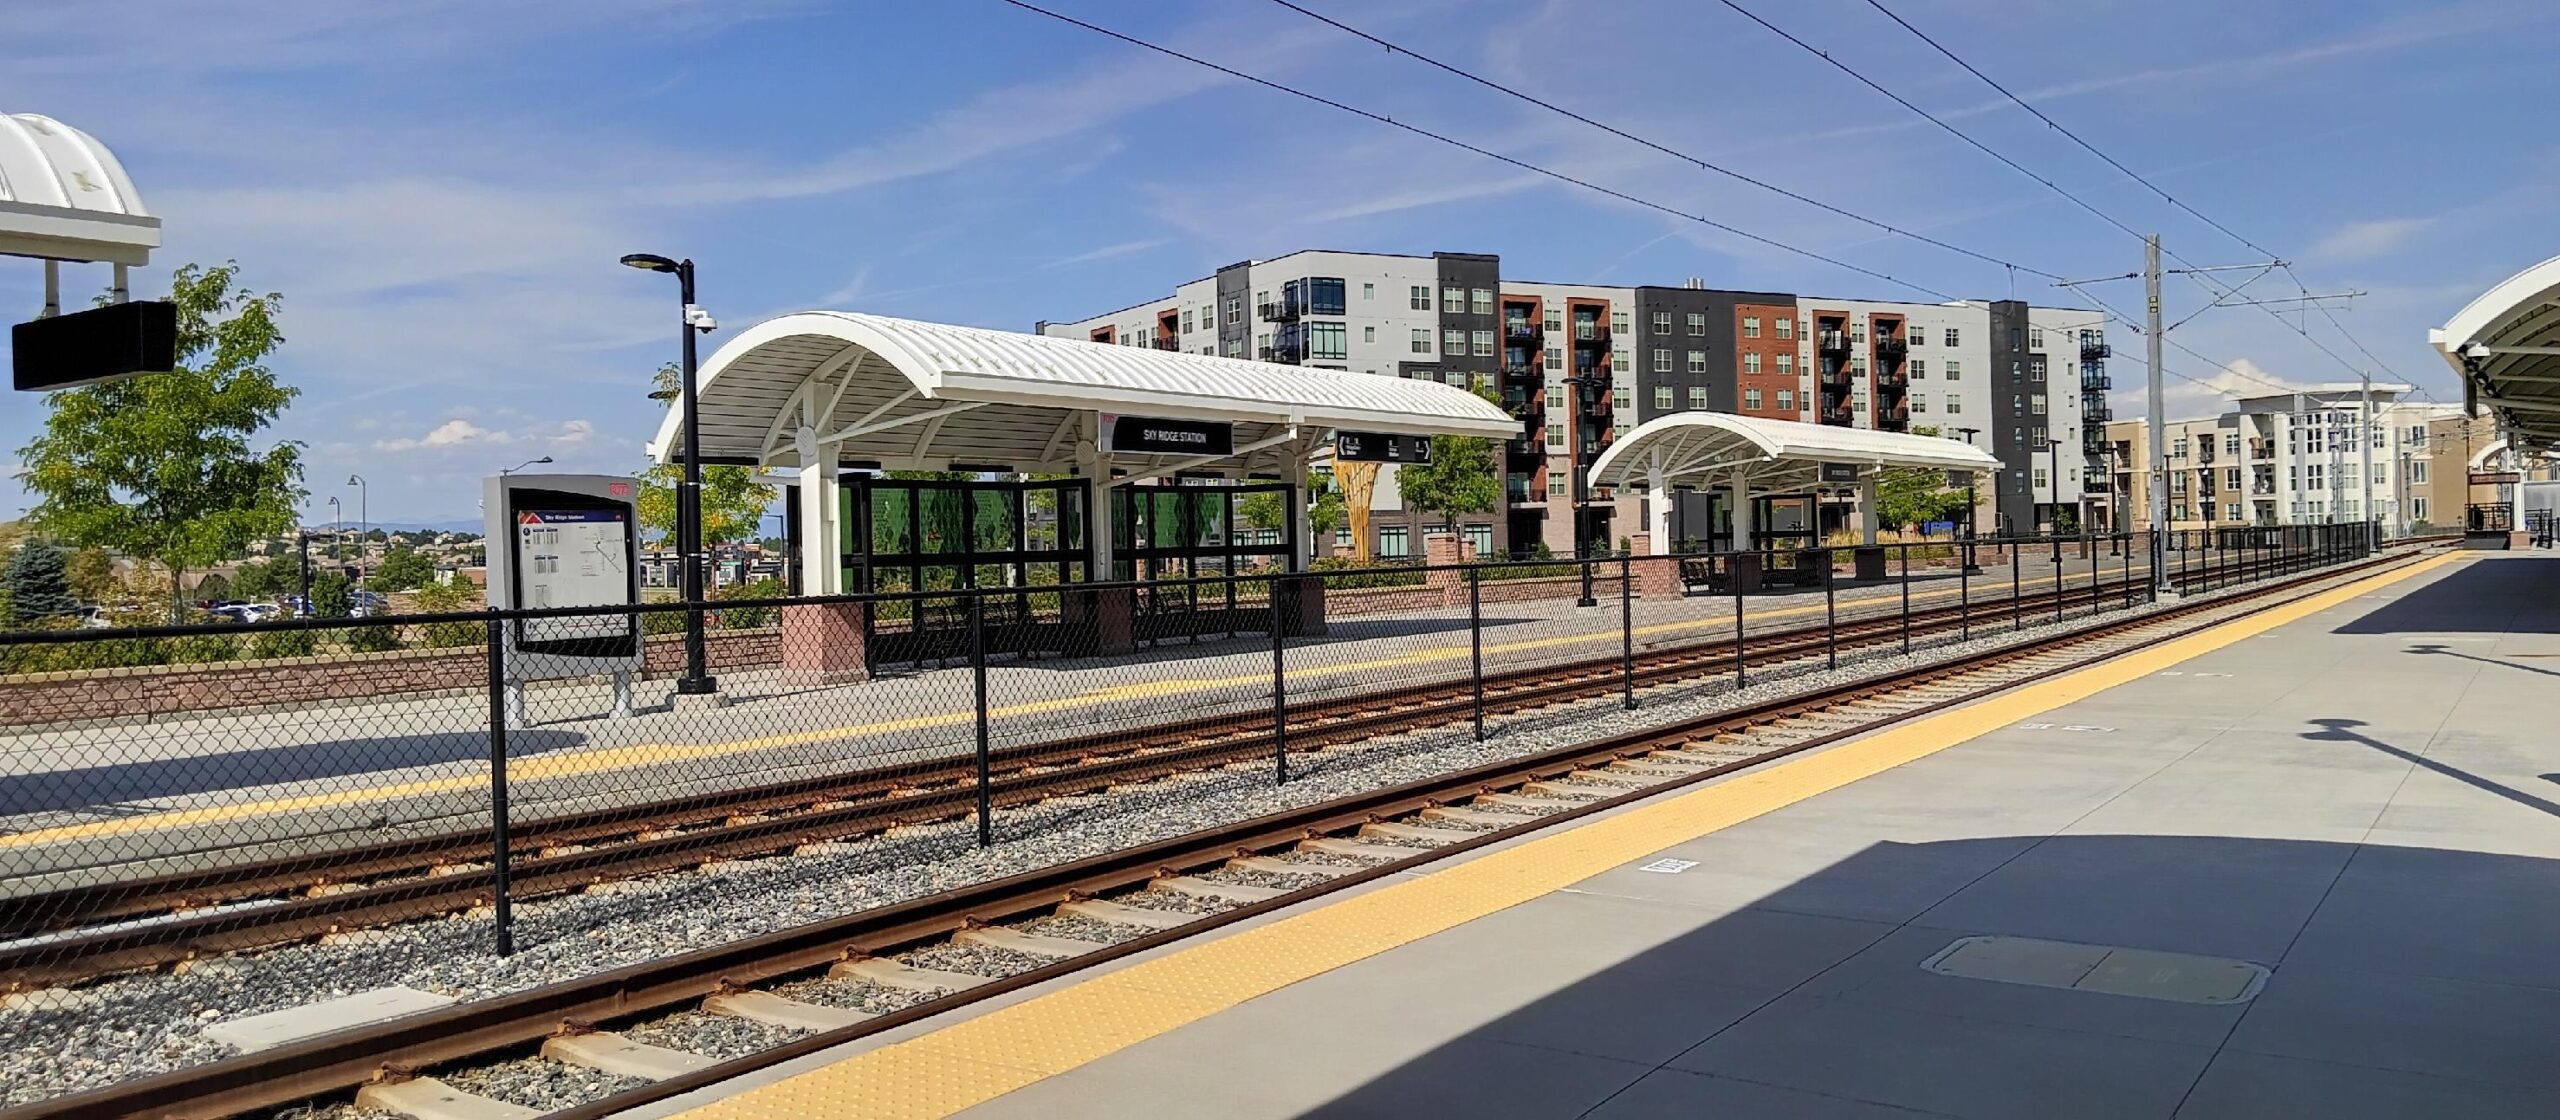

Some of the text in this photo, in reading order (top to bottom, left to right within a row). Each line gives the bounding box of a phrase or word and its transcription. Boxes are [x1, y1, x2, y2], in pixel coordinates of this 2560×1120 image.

[1143, 429, 1207, 444] SKY RIDGE STATION
